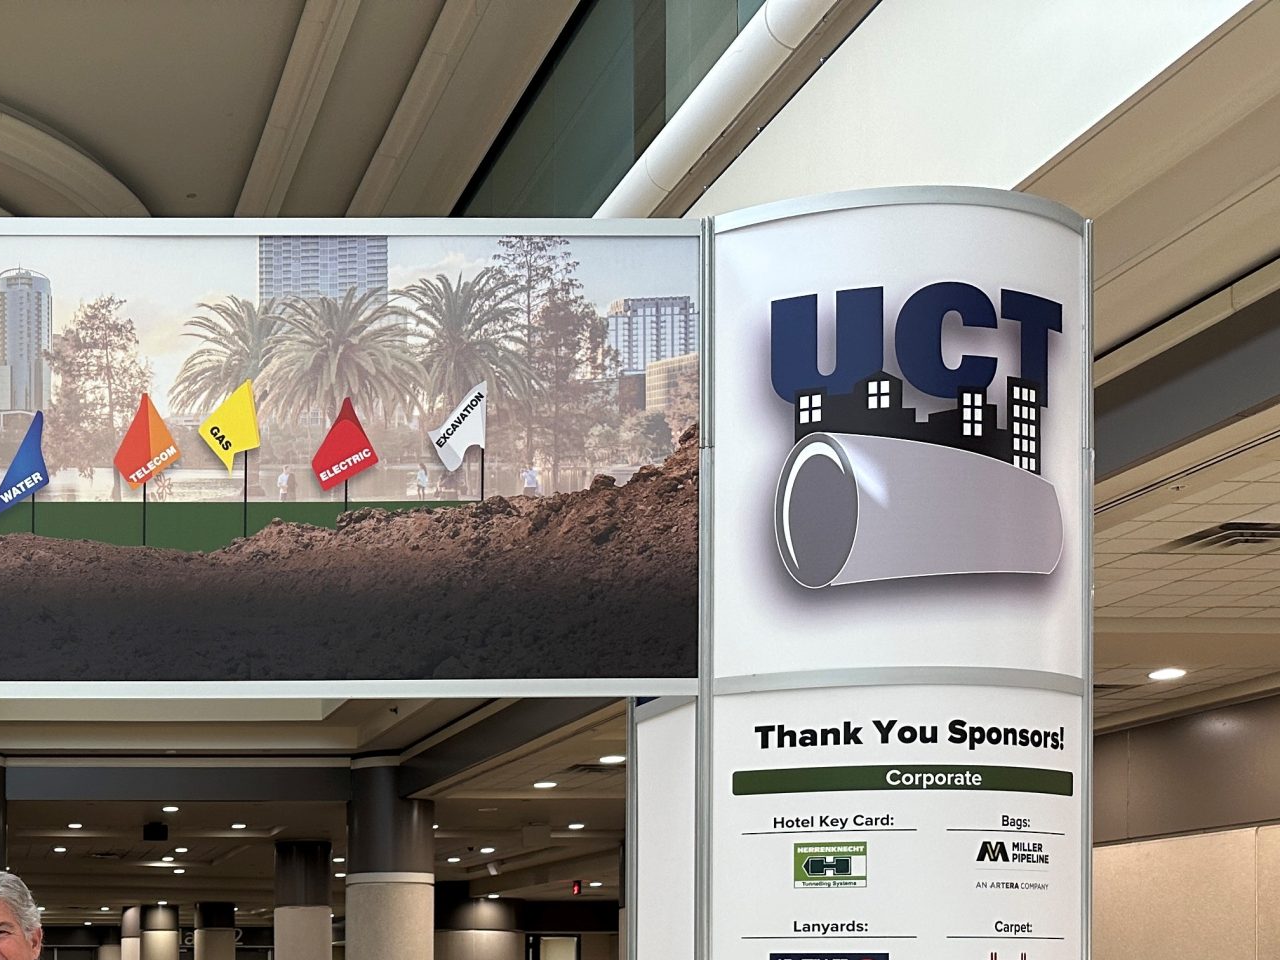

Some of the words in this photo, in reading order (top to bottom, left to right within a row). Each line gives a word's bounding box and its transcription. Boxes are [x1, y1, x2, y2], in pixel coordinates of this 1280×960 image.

[771, 282, 1063, 408] UCT
[435, 391, 486, 449] EXCAVATION
[208, 424, 233, 453] GAS
[129, 445, 178, 484] TELECOM
[320, 447, 373, 482] ELECTRIC
[0, 470, 44, 505] WATER
[755, 721, 863, 749] Thank
[872, 720, 938, 744] You
[948, 720, 1065, 751] Sponsors!
[886, 769, 982, 788] Corporate
[773, 816, 814, 829] Hotel
[819, 815, 849, 829] Key
[853, 814, 895, 827] Card:
[1001, 815, 1031, 830] Bags:
[1012, 842, 1043, 853] MILLER
[1012, 852, 1049, 864] PIPELINE
[1021, 882, 1049, 890] COMPANY
[793, 920, 869, 935] Lanyards:
[994, 920, 1033, 935] Carpet:
